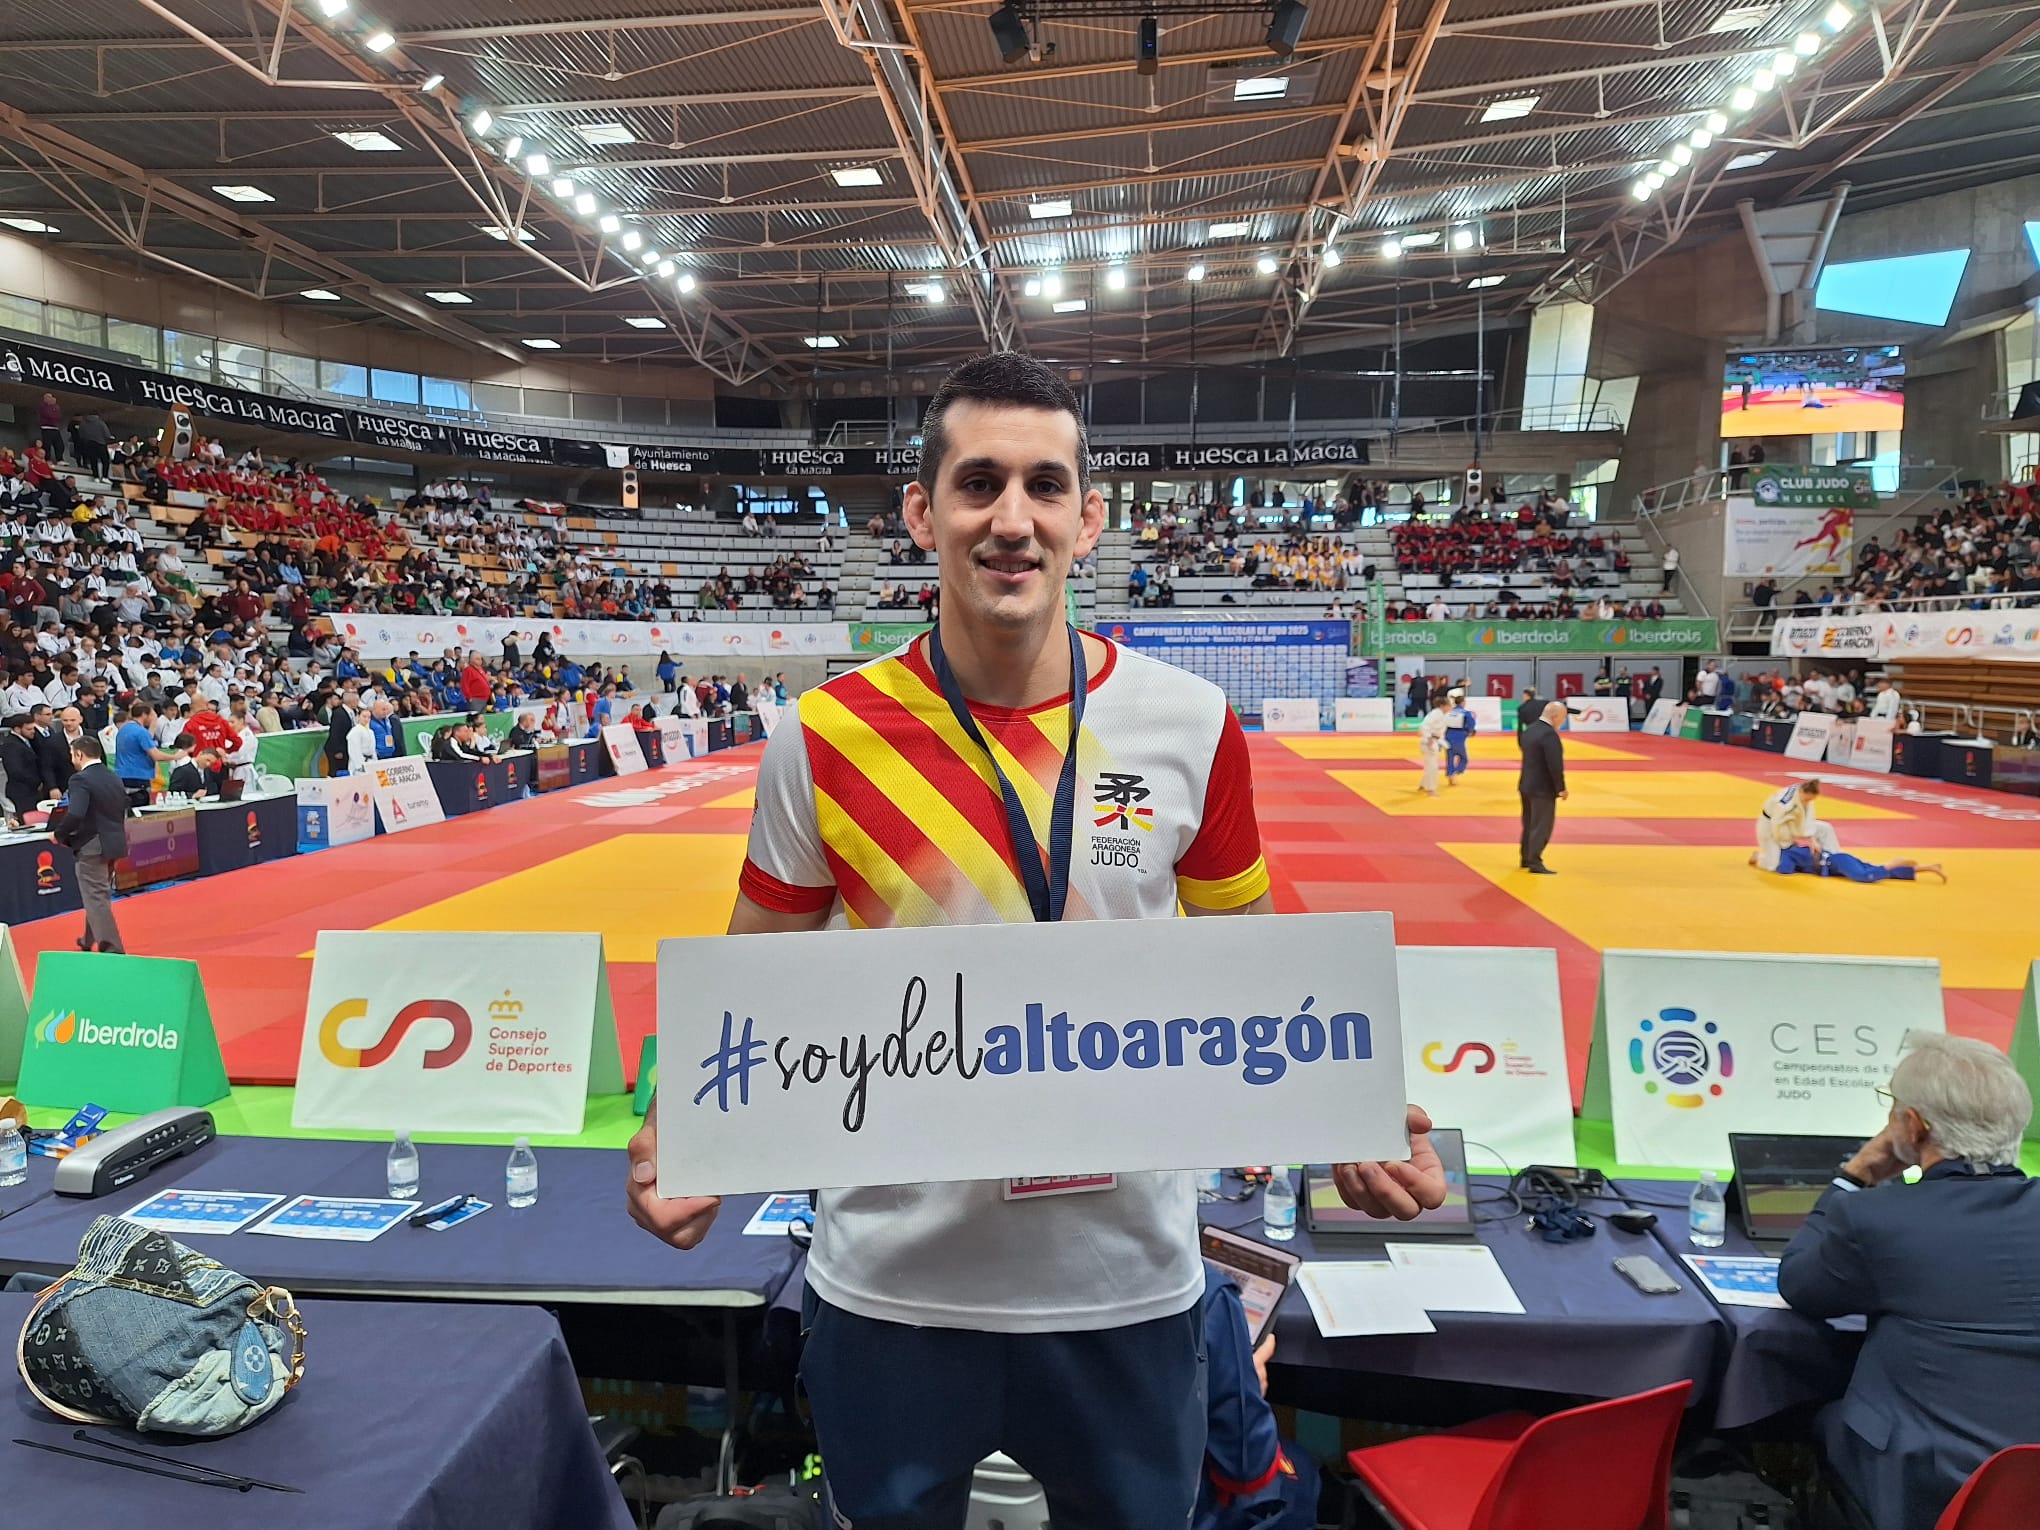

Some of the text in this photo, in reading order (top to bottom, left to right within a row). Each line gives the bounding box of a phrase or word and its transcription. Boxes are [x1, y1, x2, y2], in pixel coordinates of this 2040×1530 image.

[634, 447, 709, 460] Ayuntamiento
[875, 449, 921, 465] Hues
[650, 460, 692, 472] Huesca
[1780, 478, 1849, 489] CLUB JUDO
[874, 632, 913, 645] Iberd
[1497, 630, 1569, 644] Iberdrola
[1629, 629, 1701, 643] Iberdrola
[1091, 836, 1141, 847] FEDERACIÓN
[1092, 844, 1141, 854] ARAGONESA
[1090, 851, 1139, 868] JUDO
[78, 1018, 178, 1050] Iberdrola
[489, 1026, 547, 1042] Consejo
[488, 1042, 549, 1057] Superior
[693, 971, 1373, 1133] #soydelaltoaragón
[486, 1059, 572, 1075] de Deportes
[1774, 1060, 1860, 1073] Campeonatos
[1777, 1090, 1812, 1100] JUDO
